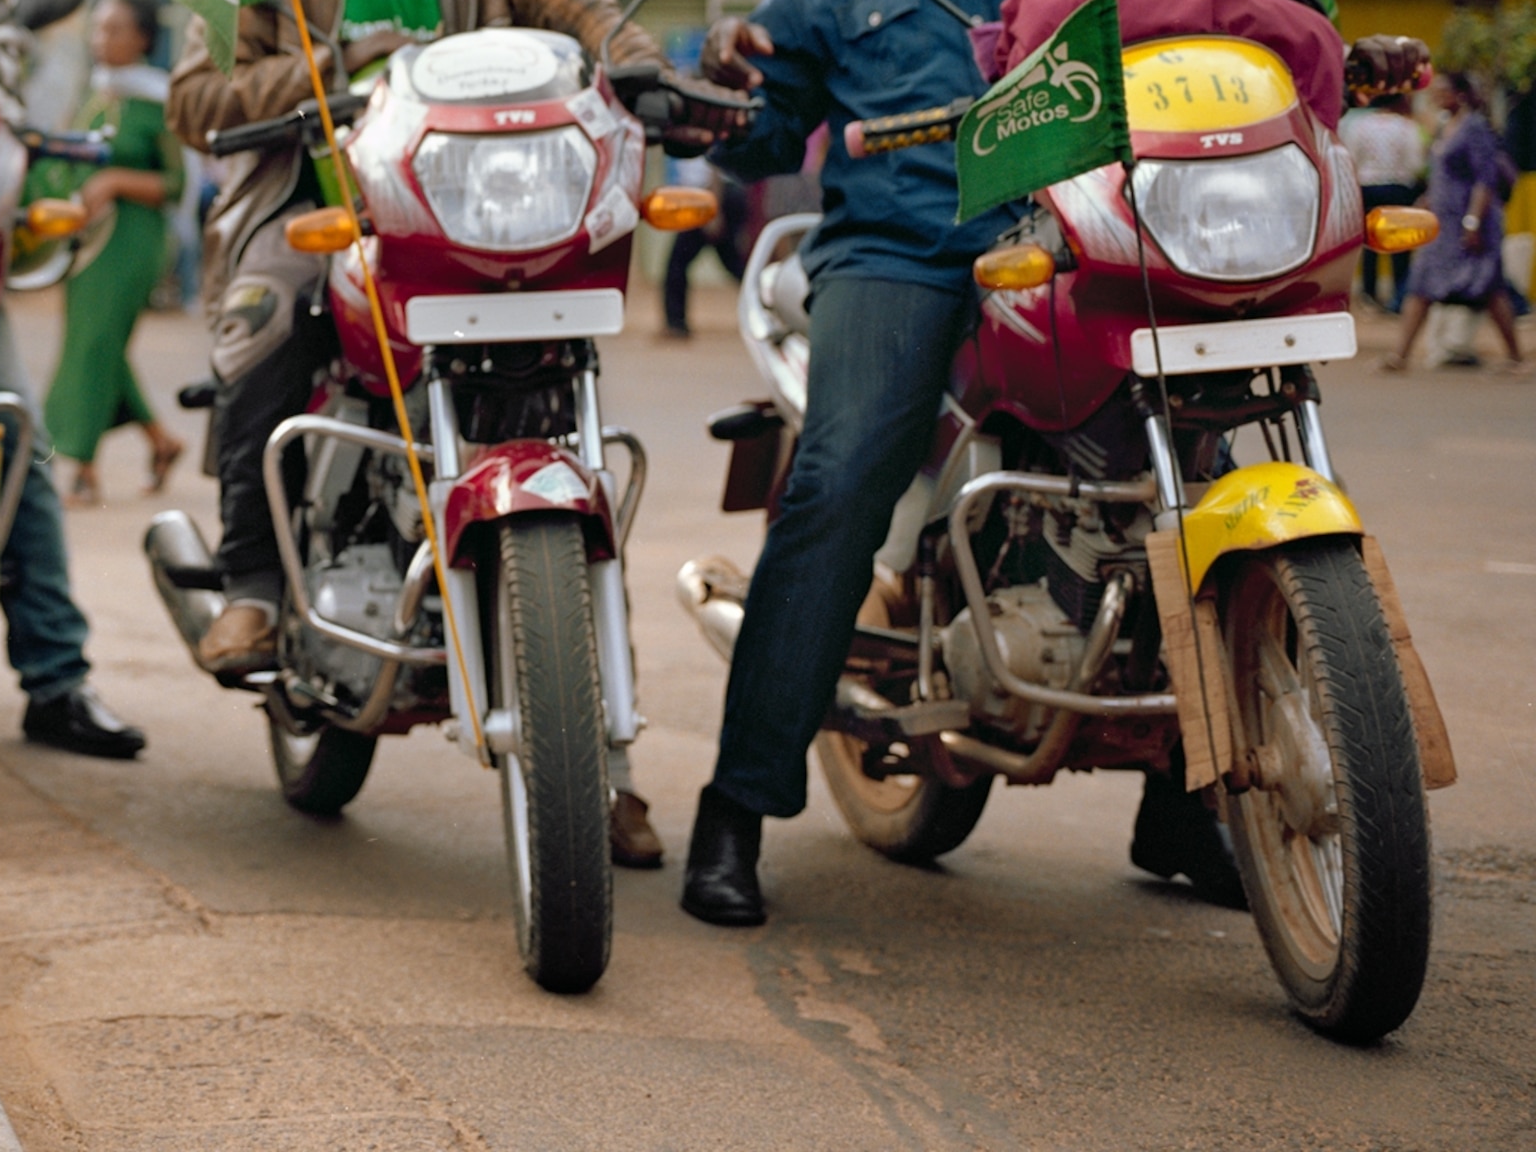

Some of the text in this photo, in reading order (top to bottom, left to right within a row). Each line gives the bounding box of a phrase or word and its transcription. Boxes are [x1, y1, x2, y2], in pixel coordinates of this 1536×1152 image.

[996, 89, 1050, 125] Safe
[997, 104, 1069, 141] Motos
[1199, 132, 1244, 148] TVS
